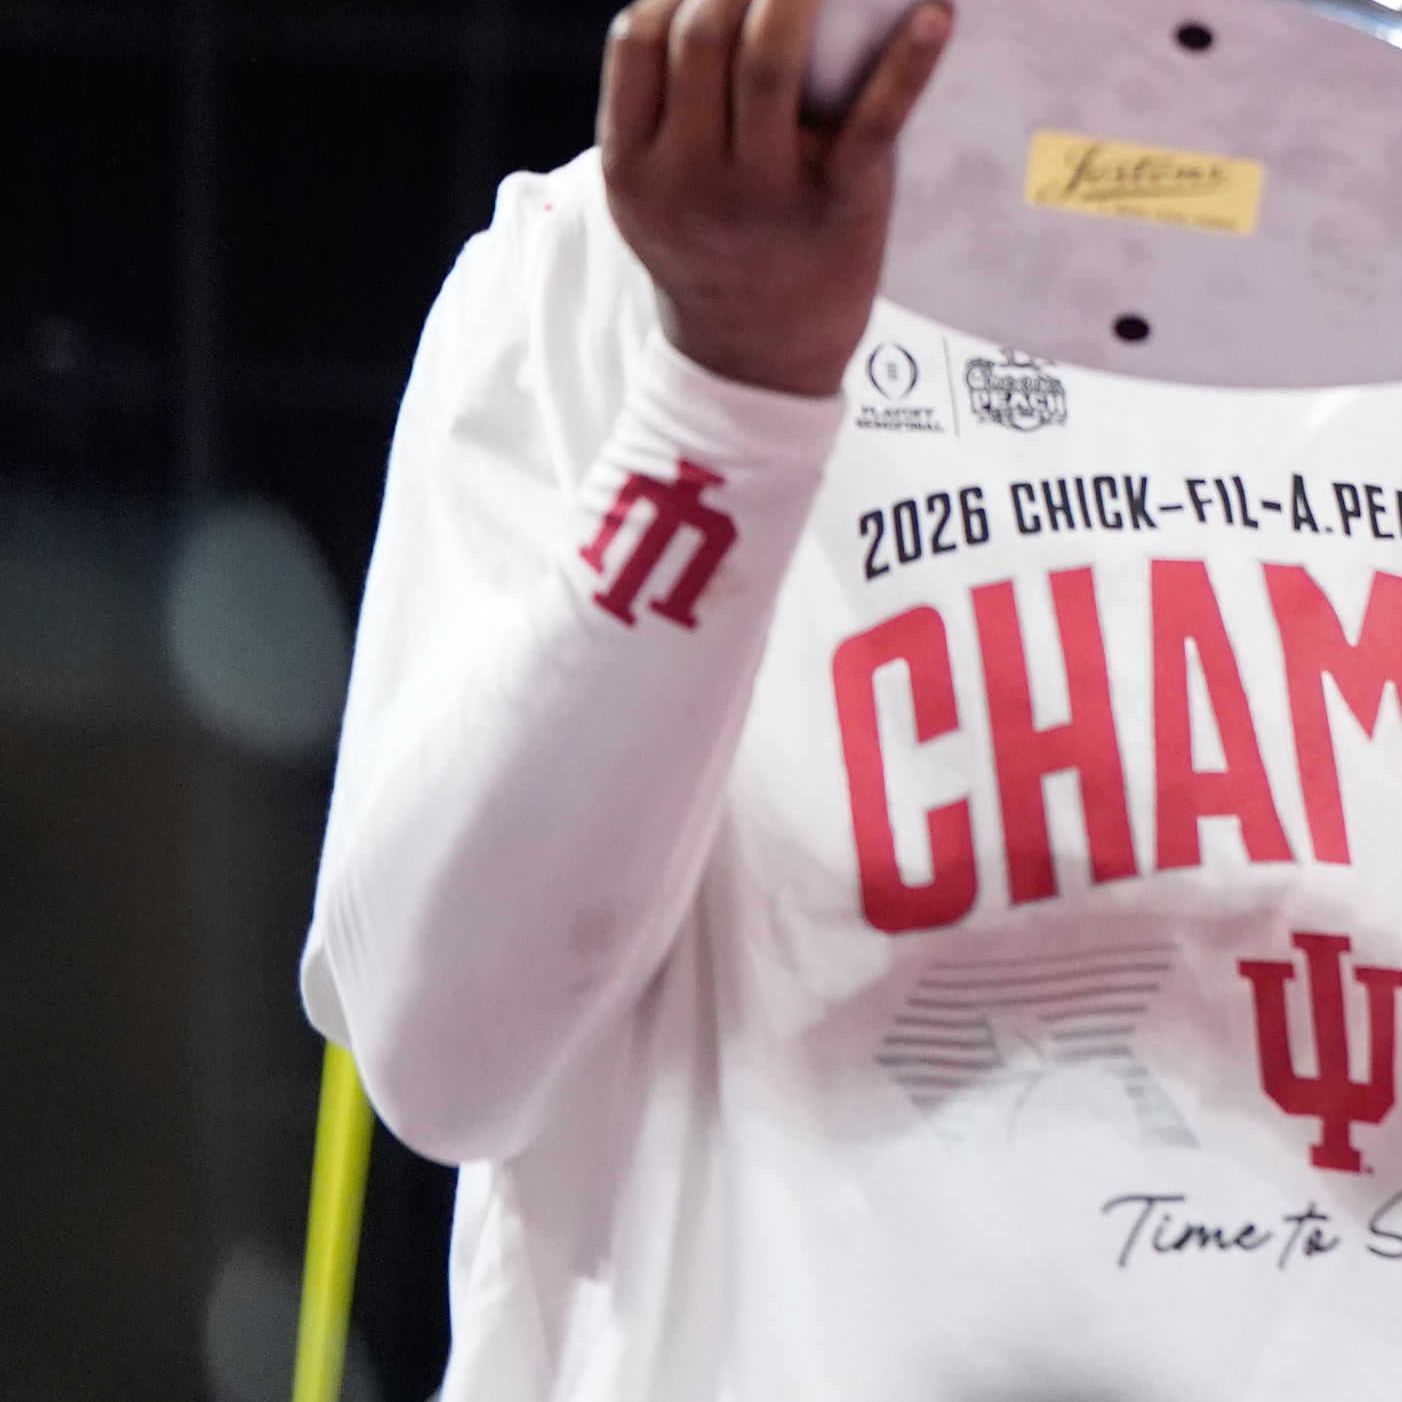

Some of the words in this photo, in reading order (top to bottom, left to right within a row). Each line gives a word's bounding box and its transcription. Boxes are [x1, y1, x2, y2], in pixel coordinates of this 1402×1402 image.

[857, 484, 991, 580] 2026
[1101, 1192, 1273, 1270] Time
[1277, 1201, 1341, 1270] to
